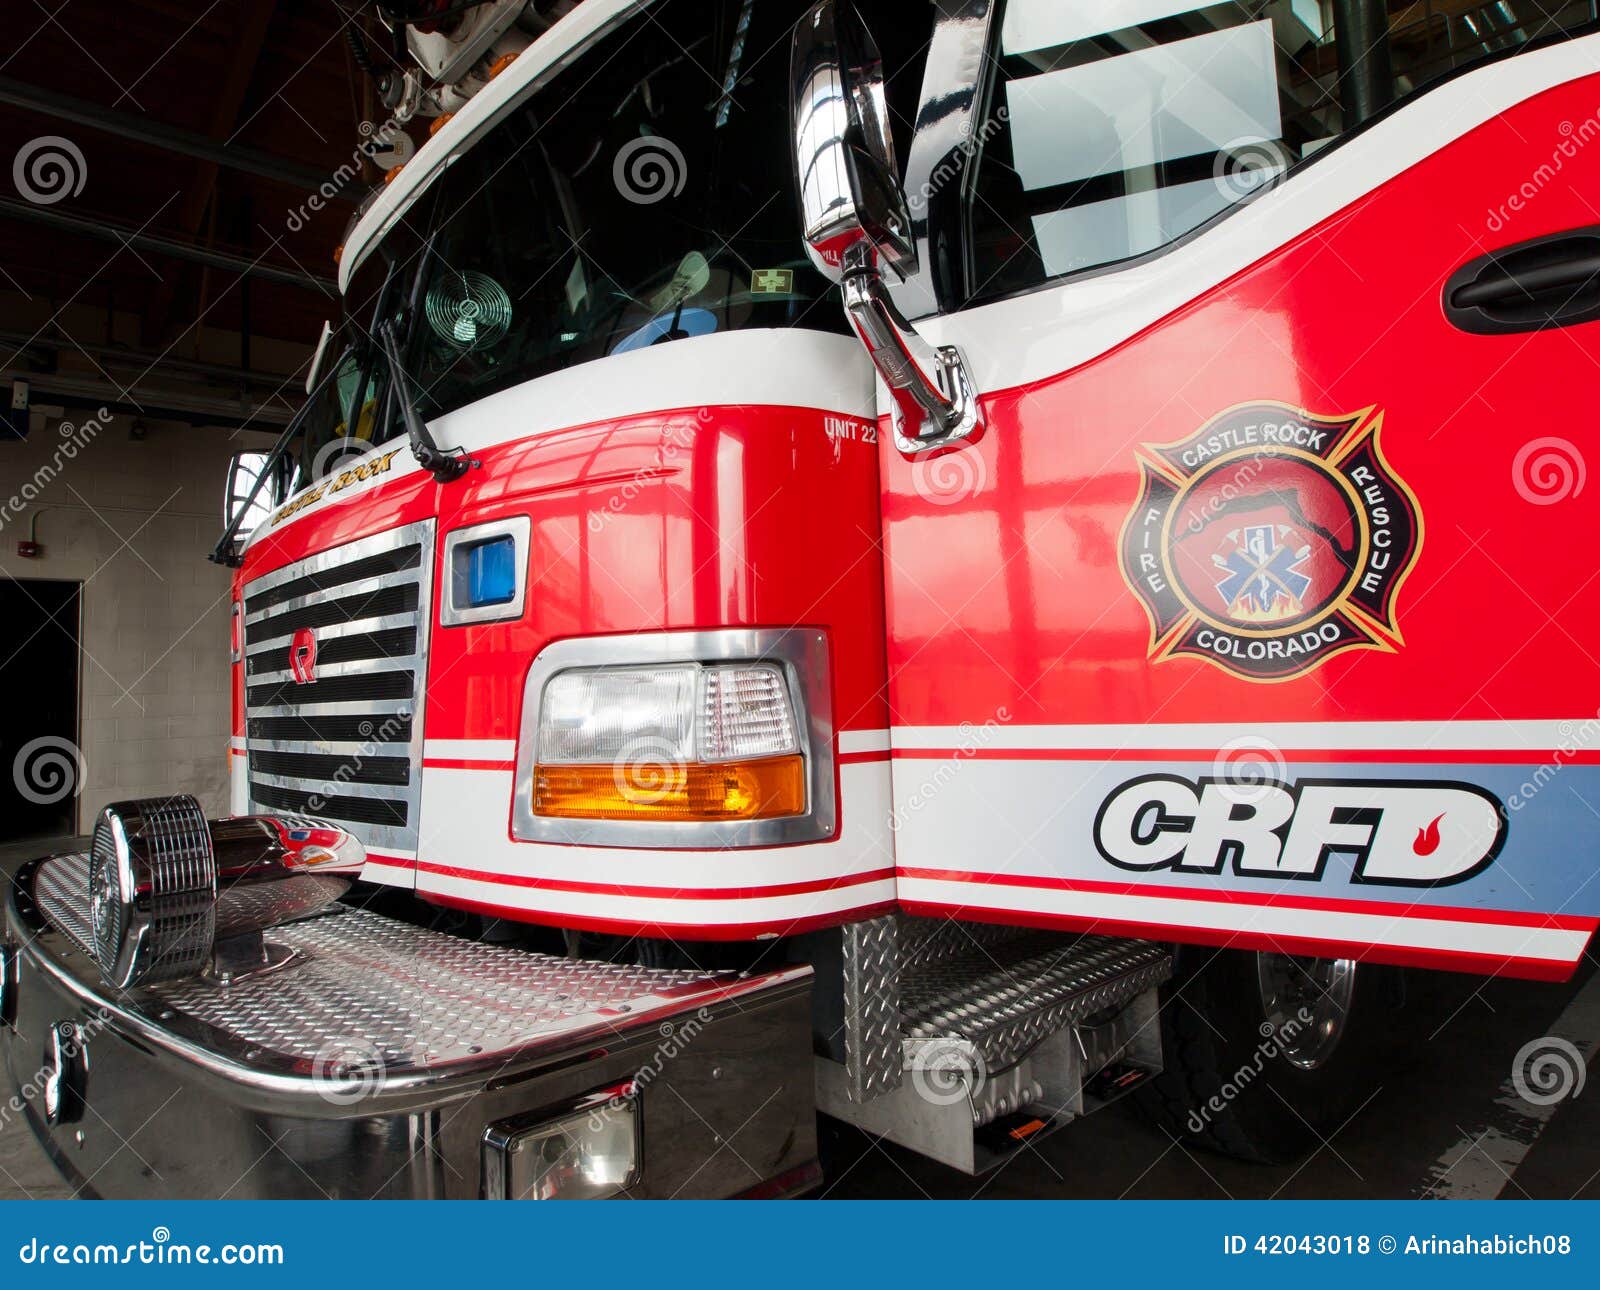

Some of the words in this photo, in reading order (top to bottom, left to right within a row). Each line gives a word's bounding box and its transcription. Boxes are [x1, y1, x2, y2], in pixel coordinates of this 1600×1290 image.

[824, 416, 858, 440] UNIT
[861, 425, 877, 444] 22
[1183, 425, 1258, 467] CASTLE
[1263, 423, 1328, 450] ROCK
[328, 446, 405, 495] ROCK
[1140, 508, 1167, 593] FIRE
[1351, 466, 1392, 593] RESCUE
[1196, 622, 1341, 659] COLORADO
[1093, 773, 1509, 888] CRFD
